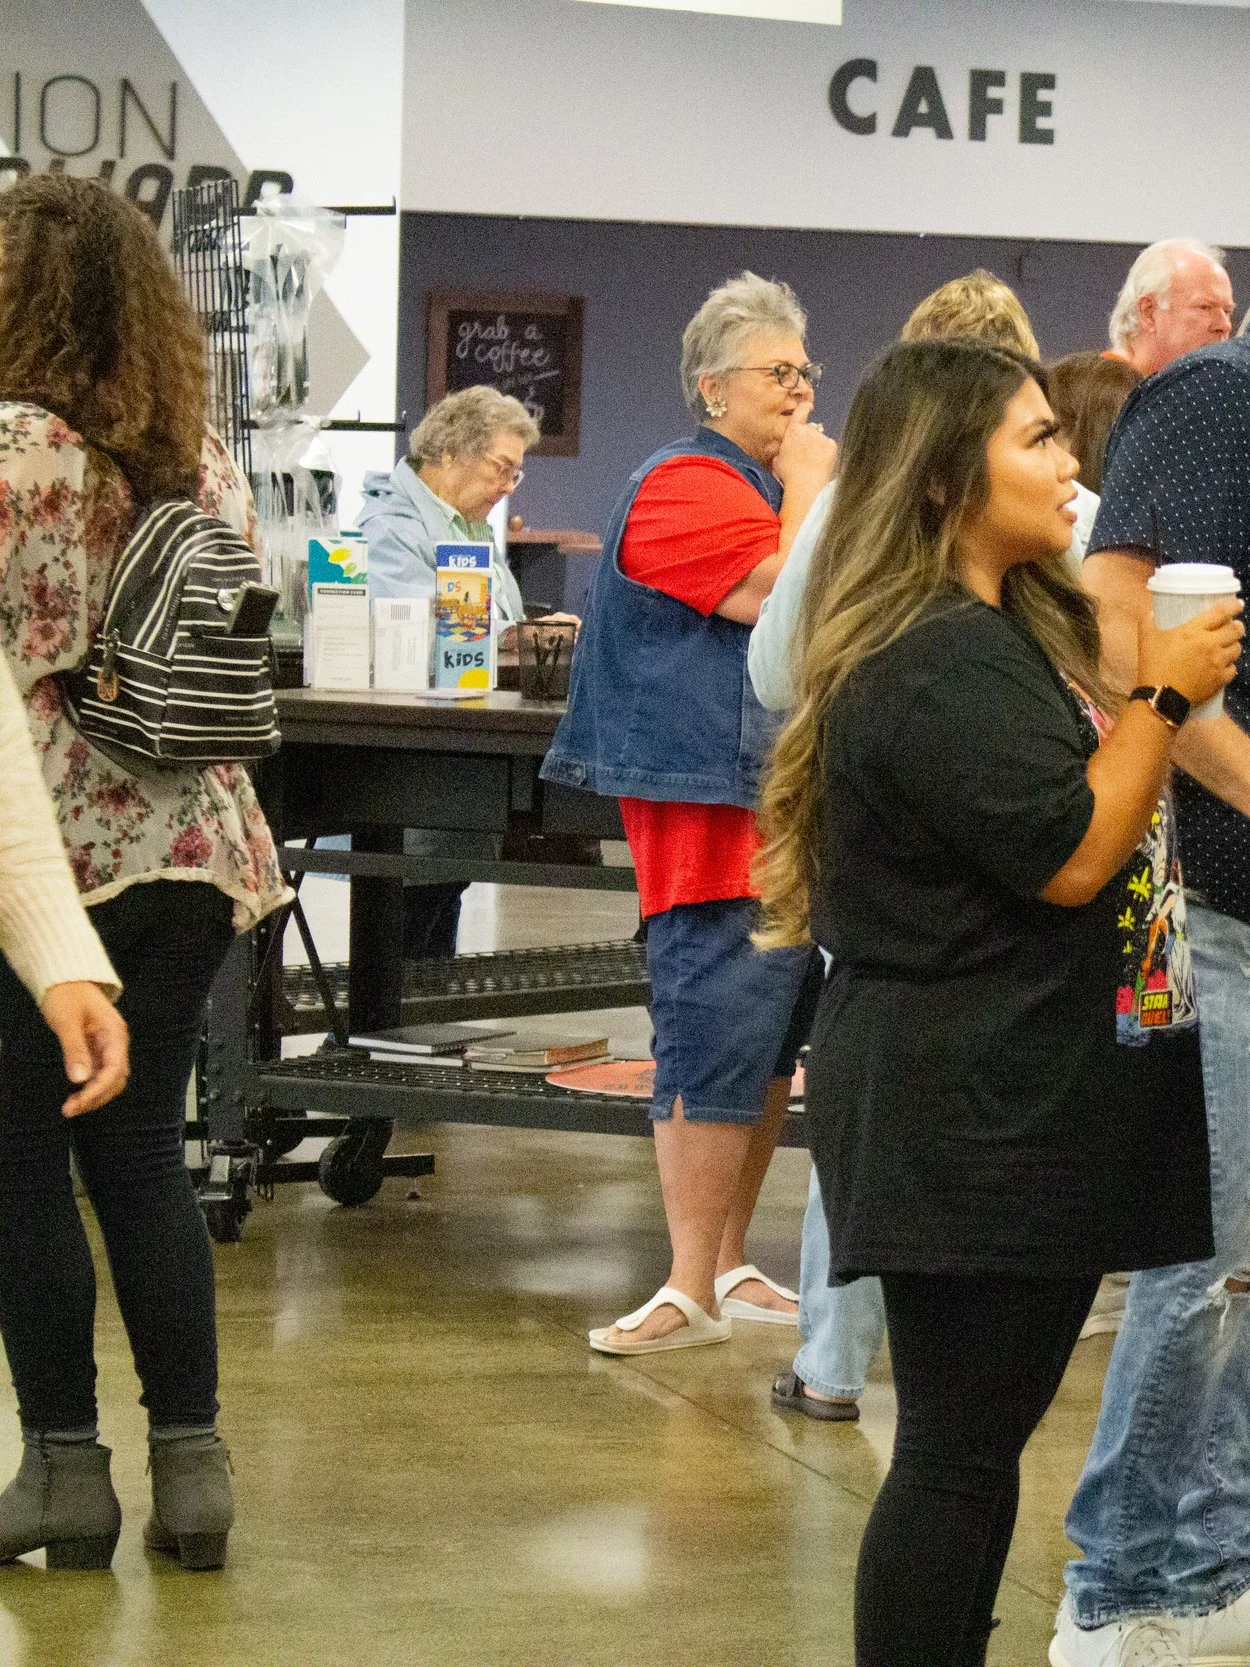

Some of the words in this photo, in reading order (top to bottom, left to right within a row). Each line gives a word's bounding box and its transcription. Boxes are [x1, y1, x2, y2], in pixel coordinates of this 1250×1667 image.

[828, 57, 1056, 145] CAFE
[456, 315, 510, 359] grab
[525, 323, 544, 341] a
[474, 341, 551, 373] coffee
